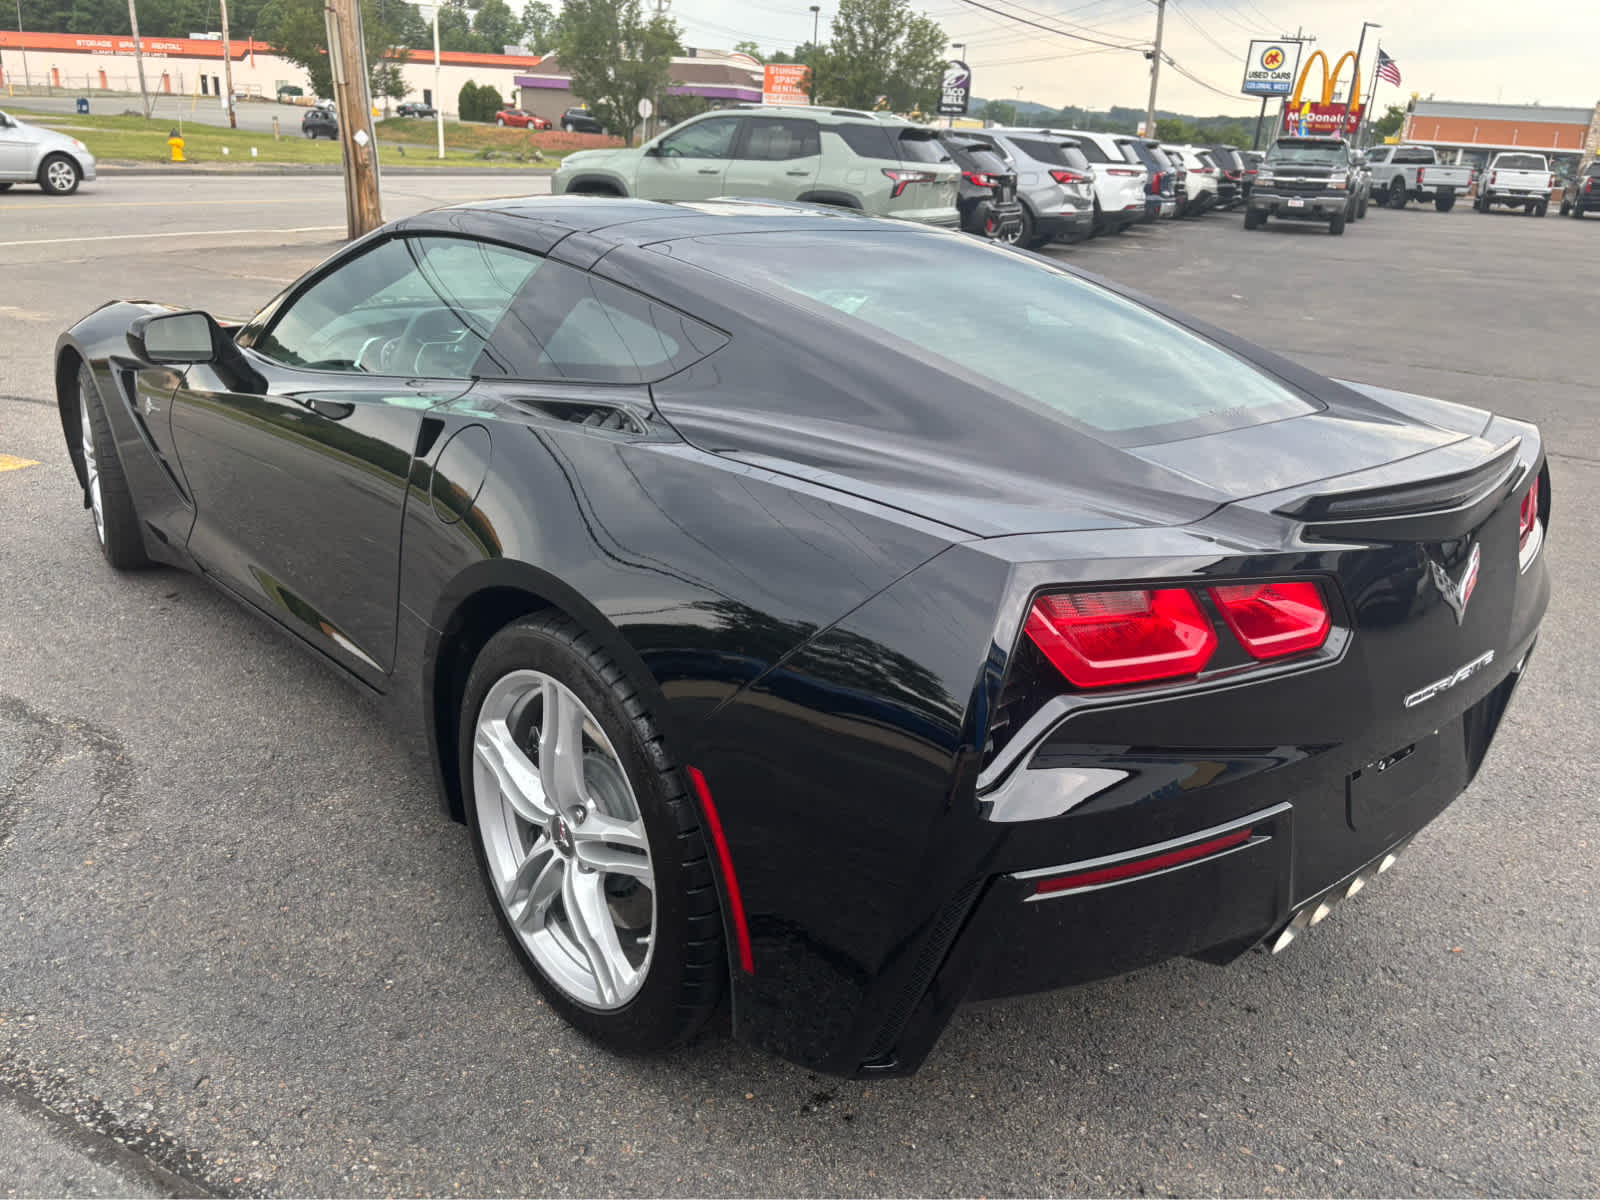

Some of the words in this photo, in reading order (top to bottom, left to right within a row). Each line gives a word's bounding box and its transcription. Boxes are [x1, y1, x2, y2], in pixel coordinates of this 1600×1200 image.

[76, 39, 112, 48] STORAGE
[119, 41, 145, 49] SPAE
[151, 42, 183, 51] RENTAL
[1248, 71, 1269, 79] USED
[1270, 71, 1292, 80] CARS
[943, 87, 966, 96] TACO
[942, 96, 965, 104] BELL
[1287, 111, 1357, 124] MDonal's
